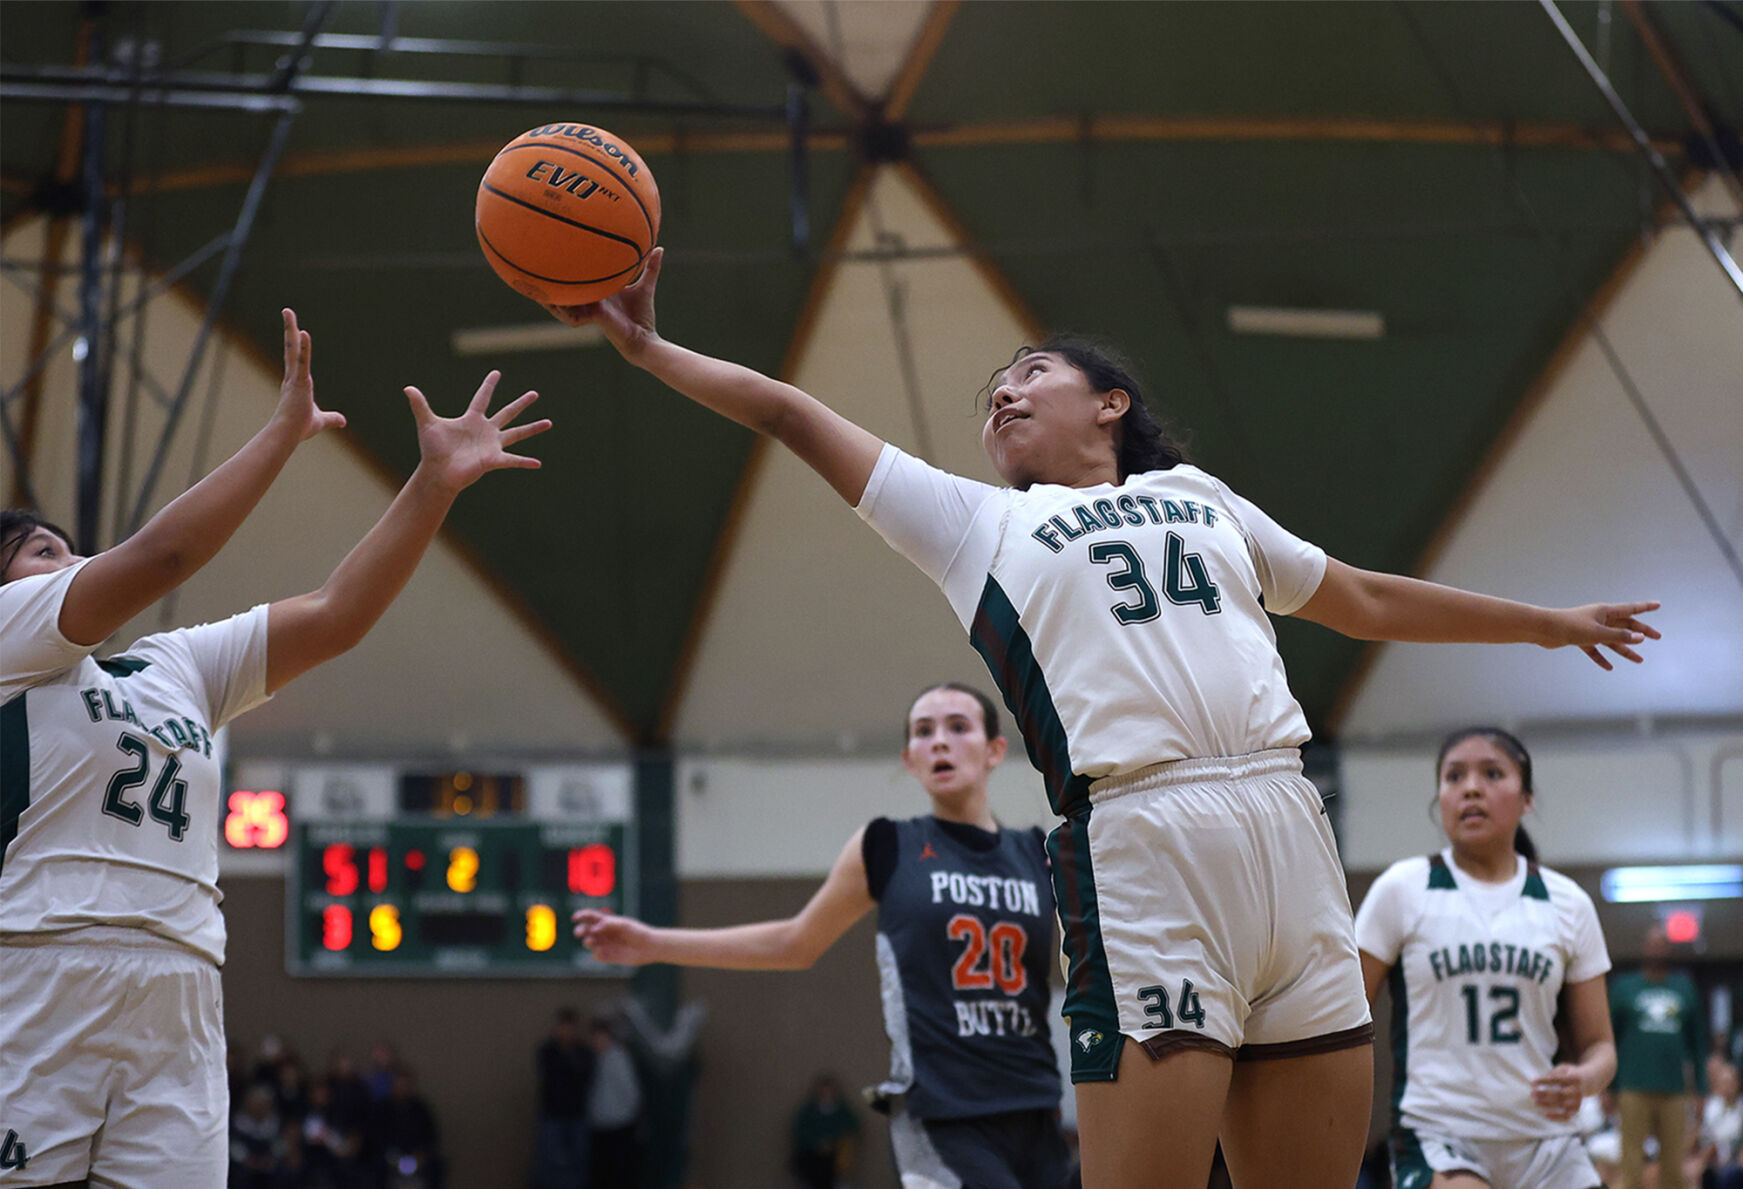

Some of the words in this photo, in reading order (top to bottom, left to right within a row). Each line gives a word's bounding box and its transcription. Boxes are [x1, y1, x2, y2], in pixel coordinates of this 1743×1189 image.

[526, 160, 600, 199] EVO
[529, 124, 638, 178] Wilson
[1031, 495, 1219, 553] FLAGSTAFF
[1089, 530, 1221, 625] 34
[80, 687, 213, 759] FLATAFF
[102, 731, 190, 842] 24
[930, 871, 1040, 917] POSTON
[947, 914, 1027, 996] 20
[1430, 943, 1553, 983] FLAGSTAFF
[1137, 978, 1205, 1029] 34
[1462, 985, 1522, 1045] 12
